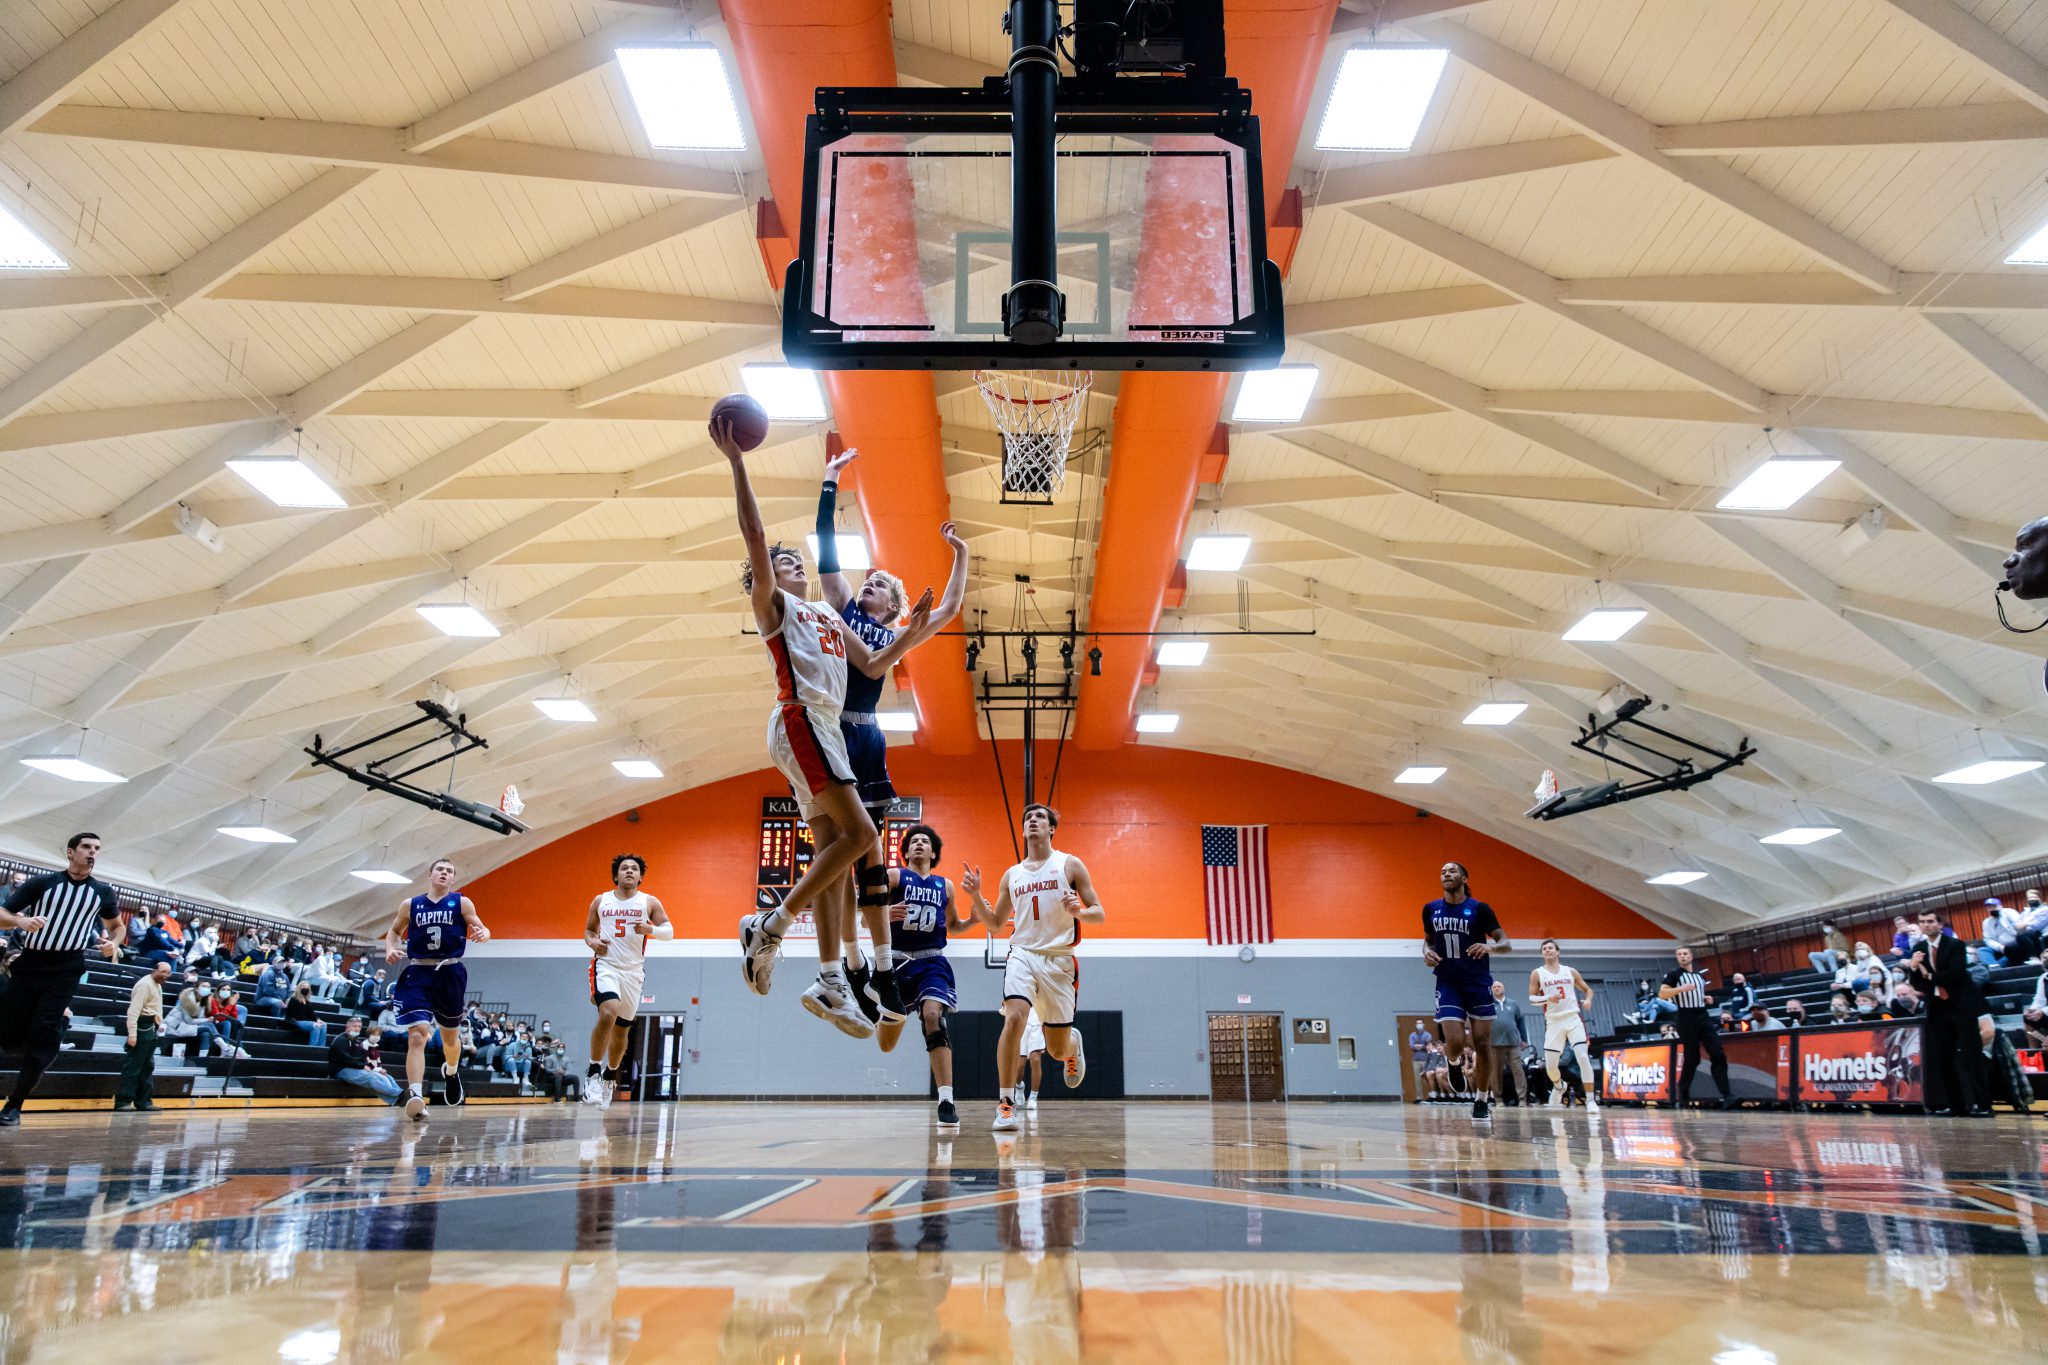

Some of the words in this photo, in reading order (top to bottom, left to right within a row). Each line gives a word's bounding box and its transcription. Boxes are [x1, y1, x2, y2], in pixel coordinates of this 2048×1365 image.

[816, 626, 845, 659] 20
[769, 801, 799, 813] KAL
[904, 884, 943, 908] CAPITAL
[1014, 879, 1059, 899] KALAMAZOO
[415, 910, 454, 928] CAPITAL
[602, 909, 643, 918] KALAMAZOO
[902, 904, 937, 933] 20
[1032, 895, 1040, 921] 1
[615, 919, 626, 938] 5
[1432, 917, 1470, 935] CAPITAL
[426, 926, 442, 951] 3
[1443, 933, 1461, 959] 11
[1556, 986, 1566, 1000] 3
[1617, 1061, 1666, 1085] Hornets
[1804, 1051, 1888, 1082] Hornets
